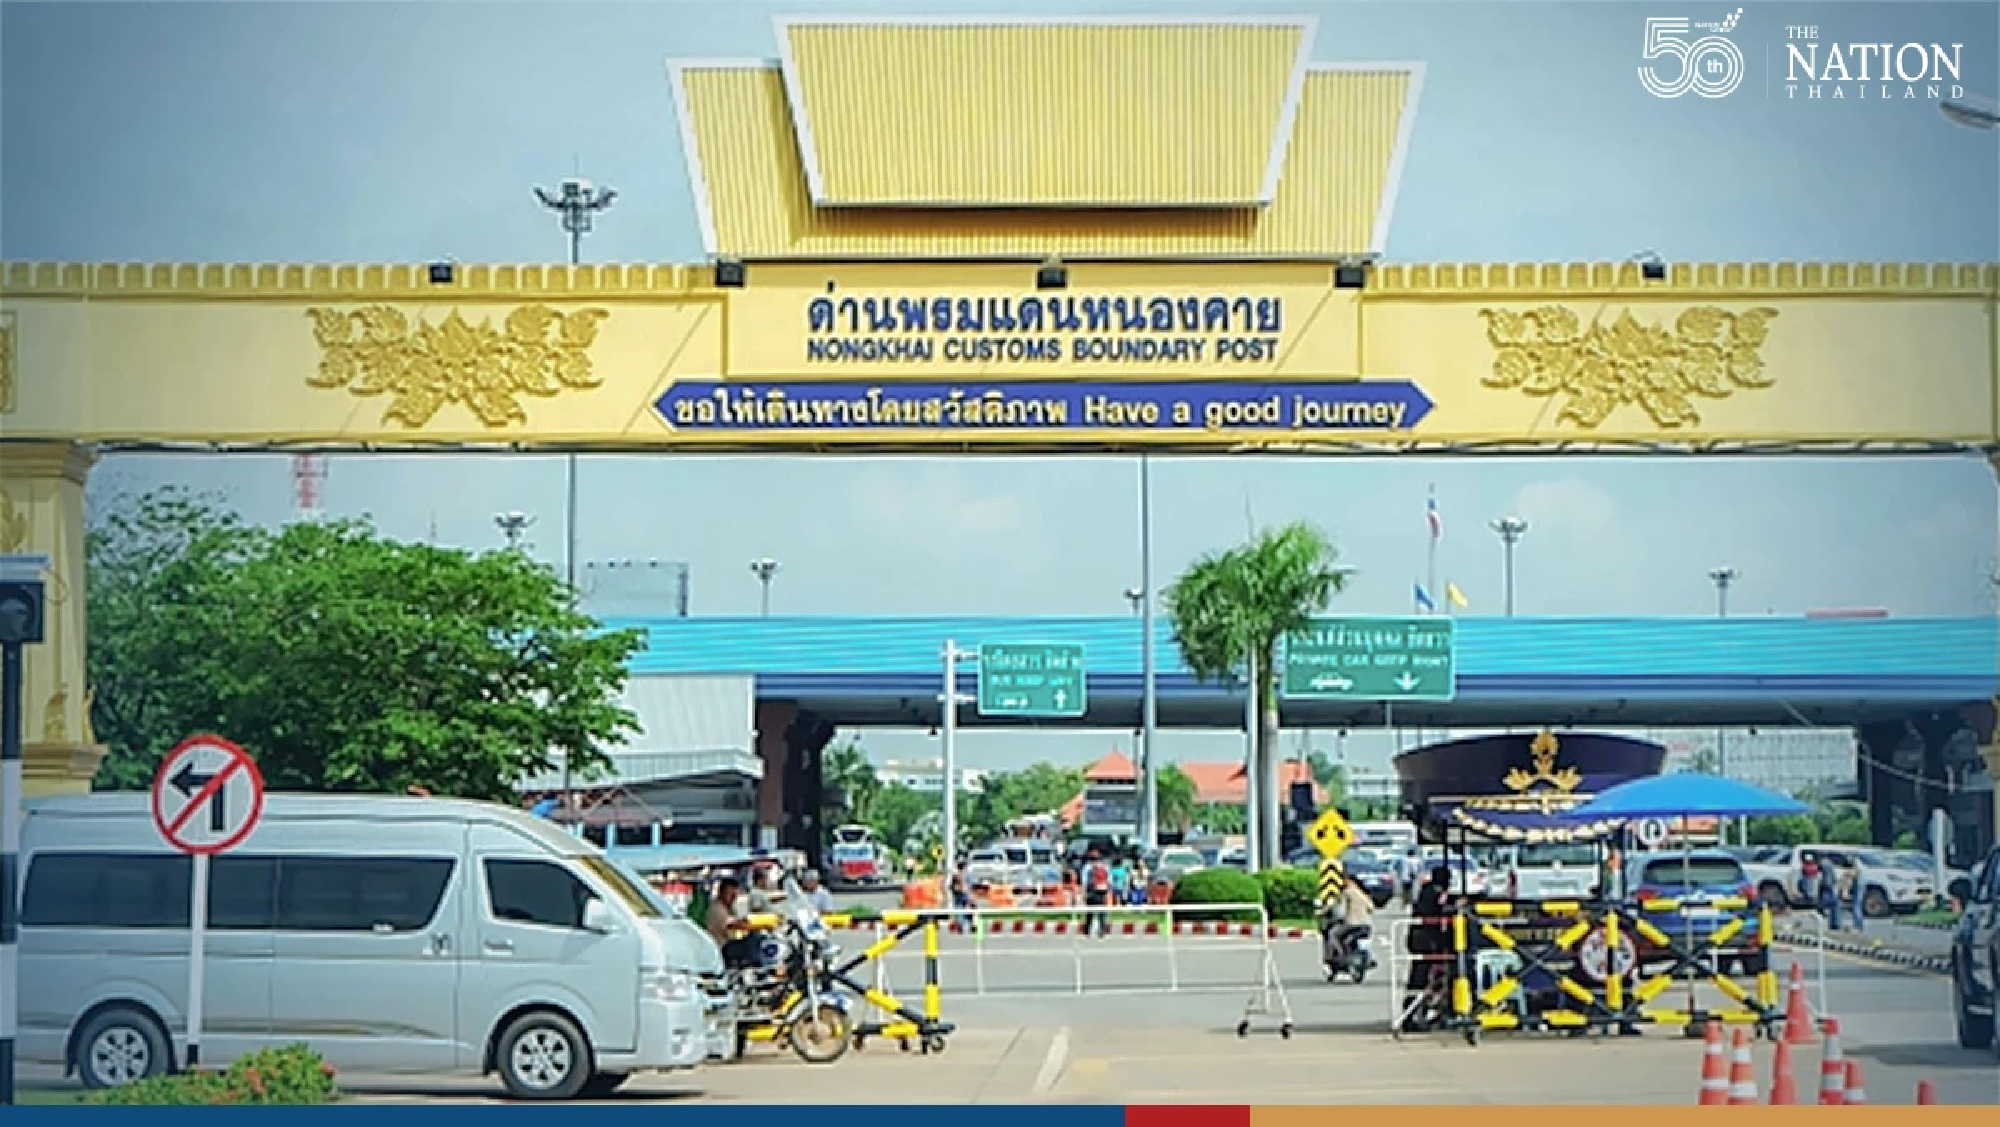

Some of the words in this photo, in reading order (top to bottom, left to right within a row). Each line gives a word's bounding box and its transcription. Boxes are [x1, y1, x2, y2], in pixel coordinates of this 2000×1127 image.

[807, 281, 1281, 332] ด่านพรมแดนหนองคาย
[807, 337, 933, 362] NONGKHAI
[944, 337, 1061, 362] CUSTOMS
[1072, 337, 1206, 362] BOUNDARY
[1216, 337, 1279, 362] POST
[674, 388, 1068, 425] ขอให้เดินทางโดยสวัสดิภาพ
[1084, 395, 1159, 424] Have
[1172, 402, 1191, 424] a
[1204, 394, 1281, 432] good
[1291, 394, 1407, 432] journey
